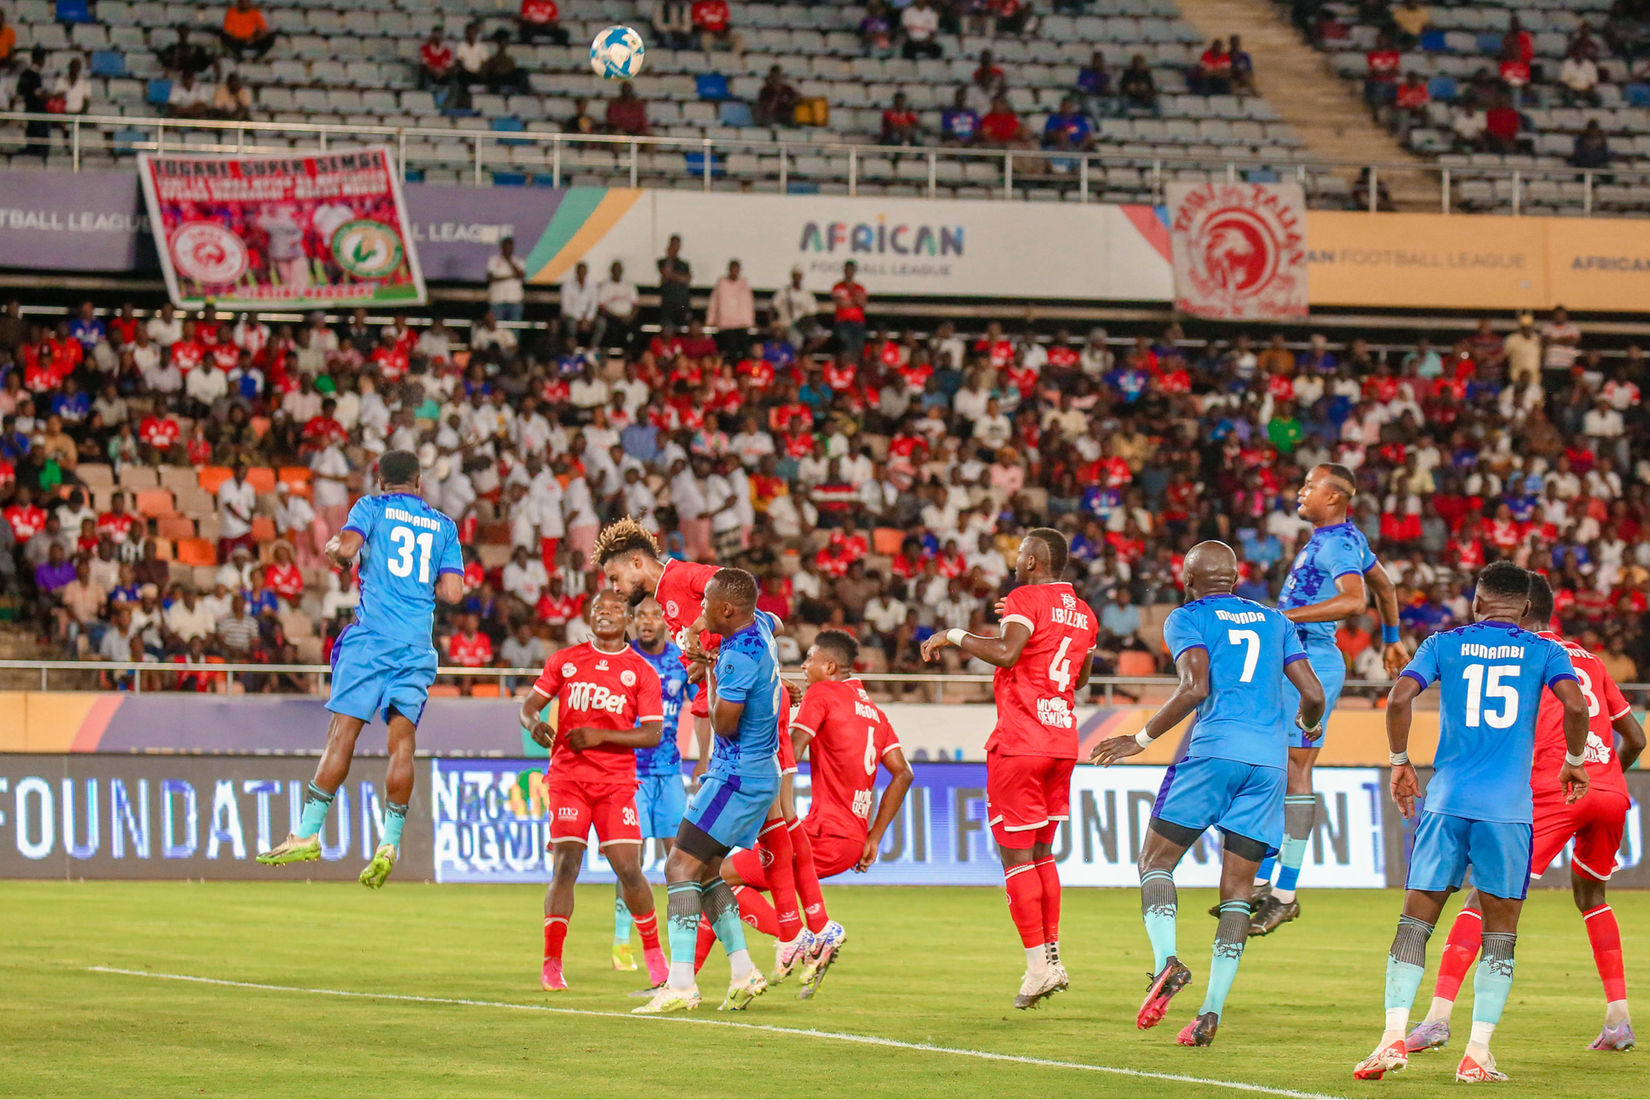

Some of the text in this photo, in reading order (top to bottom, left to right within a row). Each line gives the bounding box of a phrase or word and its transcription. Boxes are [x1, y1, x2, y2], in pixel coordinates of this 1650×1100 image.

[800, 213, 965, 256] AFRICAN
[890, 262, 951, 277] LEAGUE
[1339, 249, 1444, 268] FOOTBALL
[1449, 250, 1525, 270] LEAGUE
[387, 526, 434, 583] 31
[1049, 636, 1072, 693] 4
[1228, 629, 1261, 683] 7
[1461, 643, 1525, 660] KUNAMBI
[1462, 664, 1521, 729] 15
[864, 726, 877, 776] 6
[622, 806, 638, 827] 38
